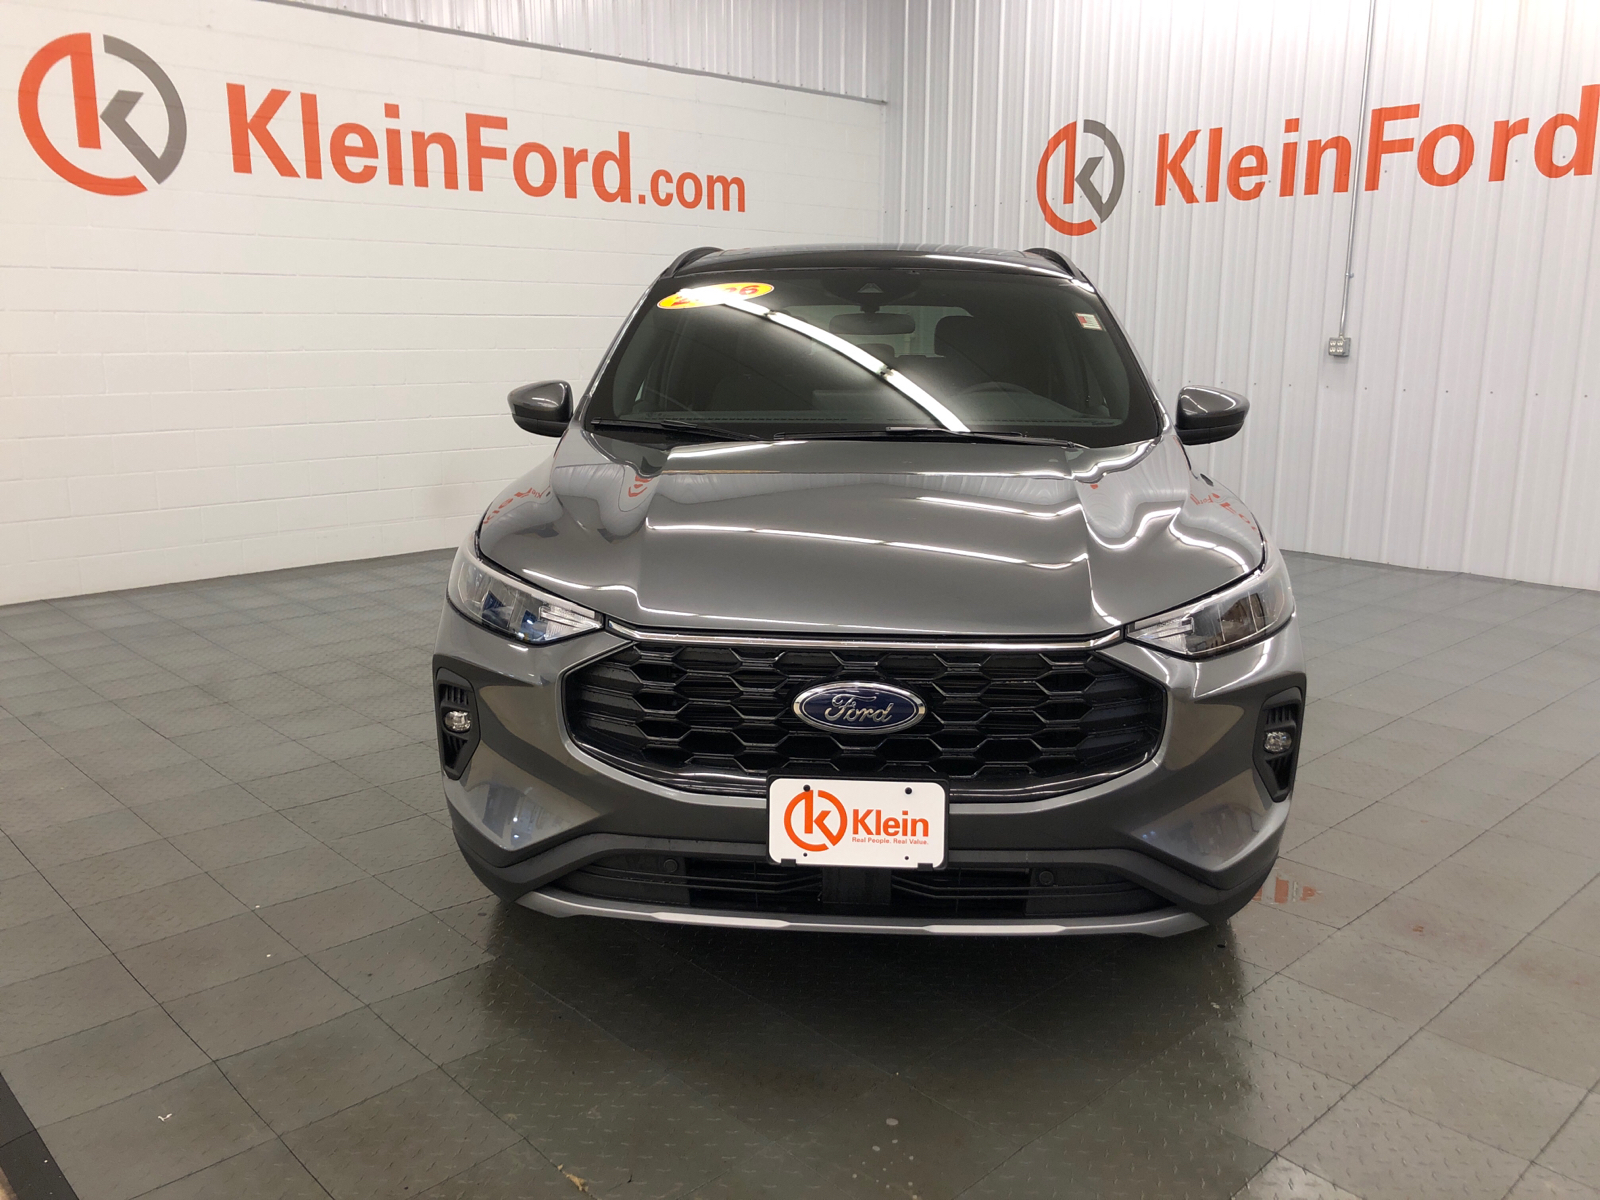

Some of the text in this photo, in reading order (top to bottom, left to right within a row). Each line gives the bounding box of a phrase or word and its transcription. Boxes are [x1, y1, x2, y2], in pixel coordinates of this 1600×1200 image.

[225, 82, 747, 213] KleinFord.com
[1154, 84, 1600, 206] KleinFord
[825, 694, 895, 723] Ford
[852, 809, 929, 838] Klein
[868, 837, 891, 845] People.
